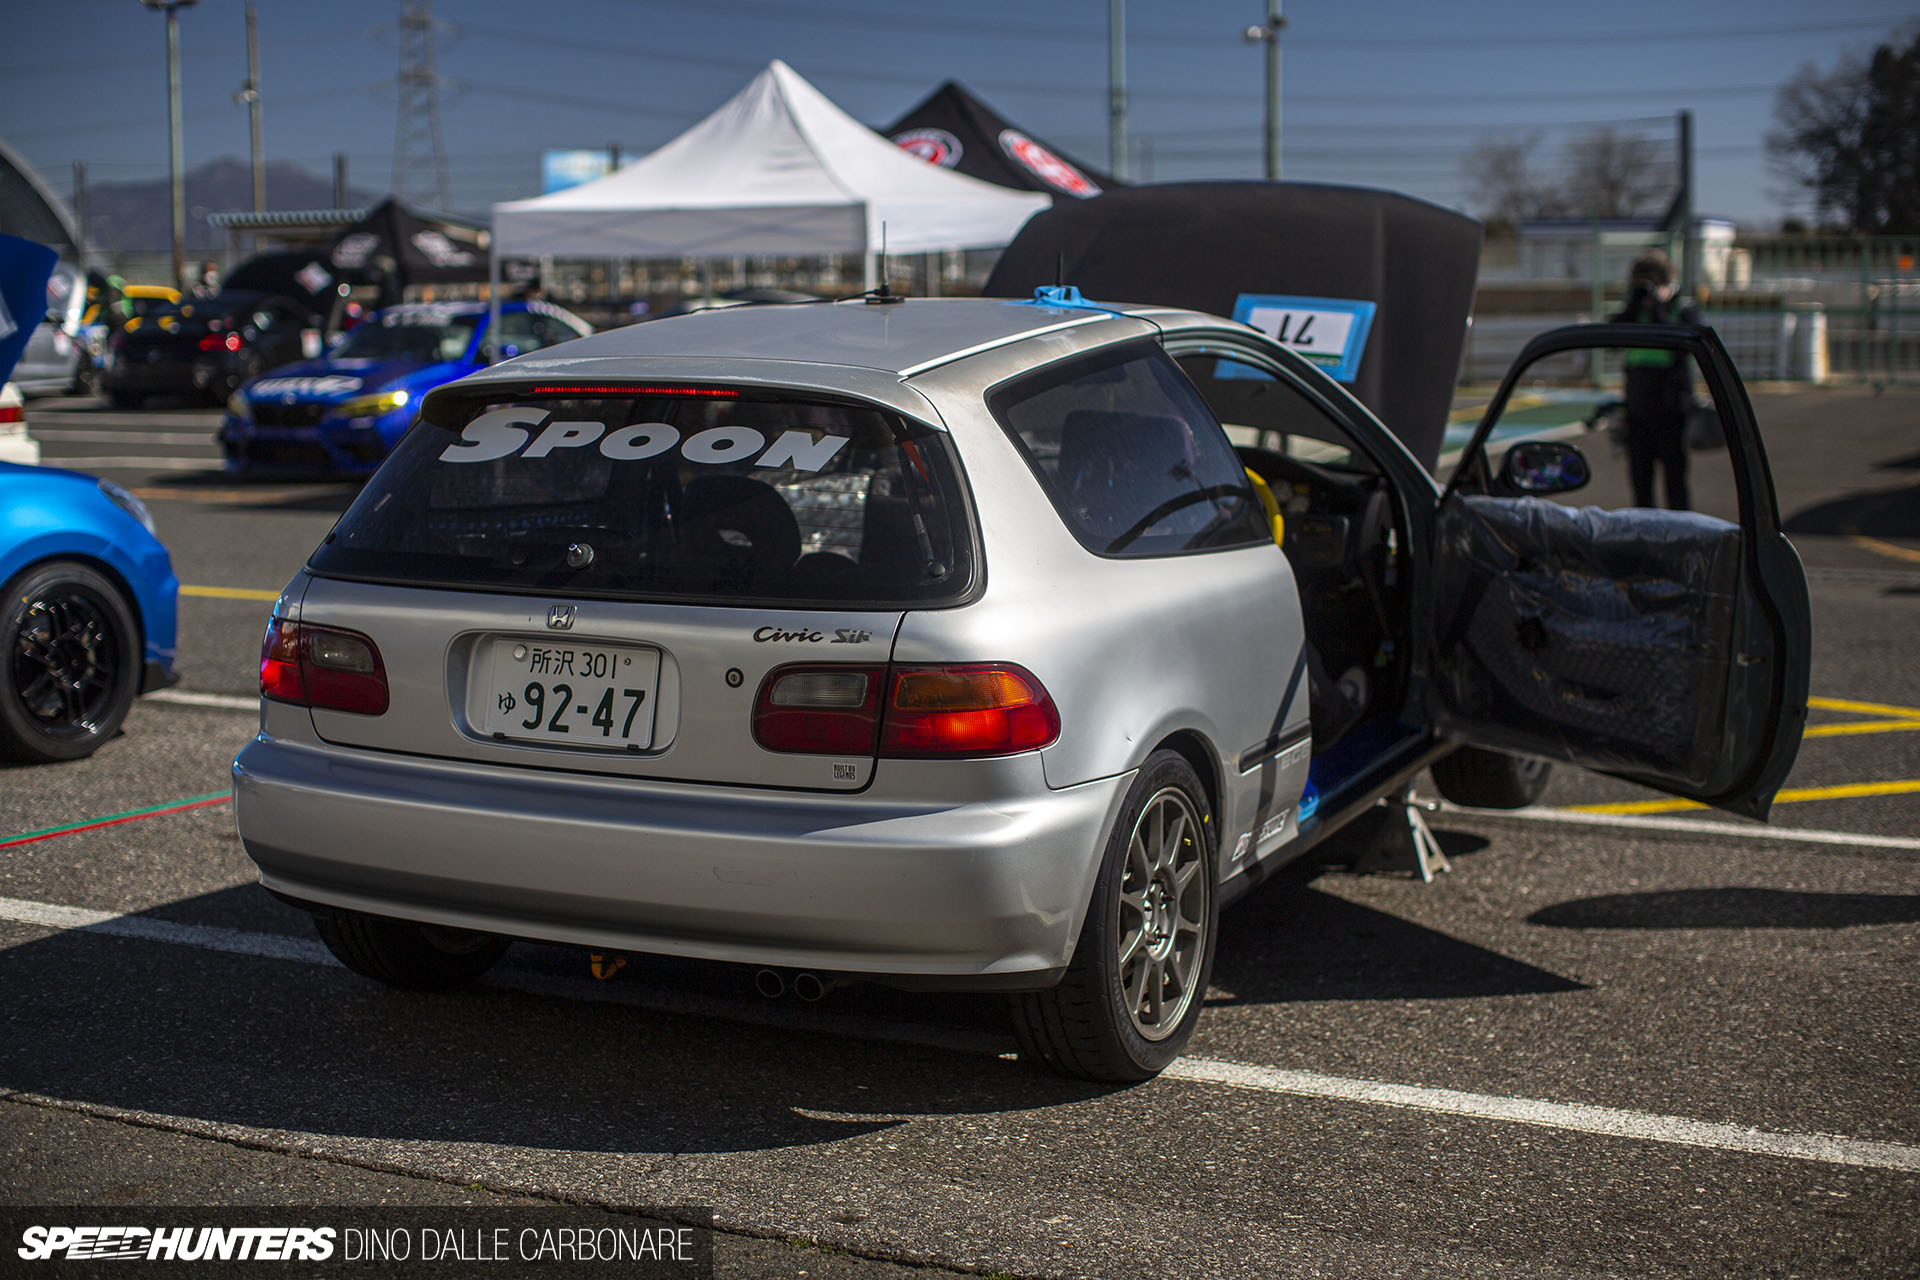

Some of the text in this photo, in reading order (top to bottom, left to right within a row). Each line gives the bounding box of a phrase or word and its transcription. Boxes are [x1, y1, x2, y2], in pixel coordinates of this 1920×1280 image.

[438, 406, 851, 472] SPOON
[753, 626, 824, 643] Civic
[522, 681, 646, 738] 92-47
